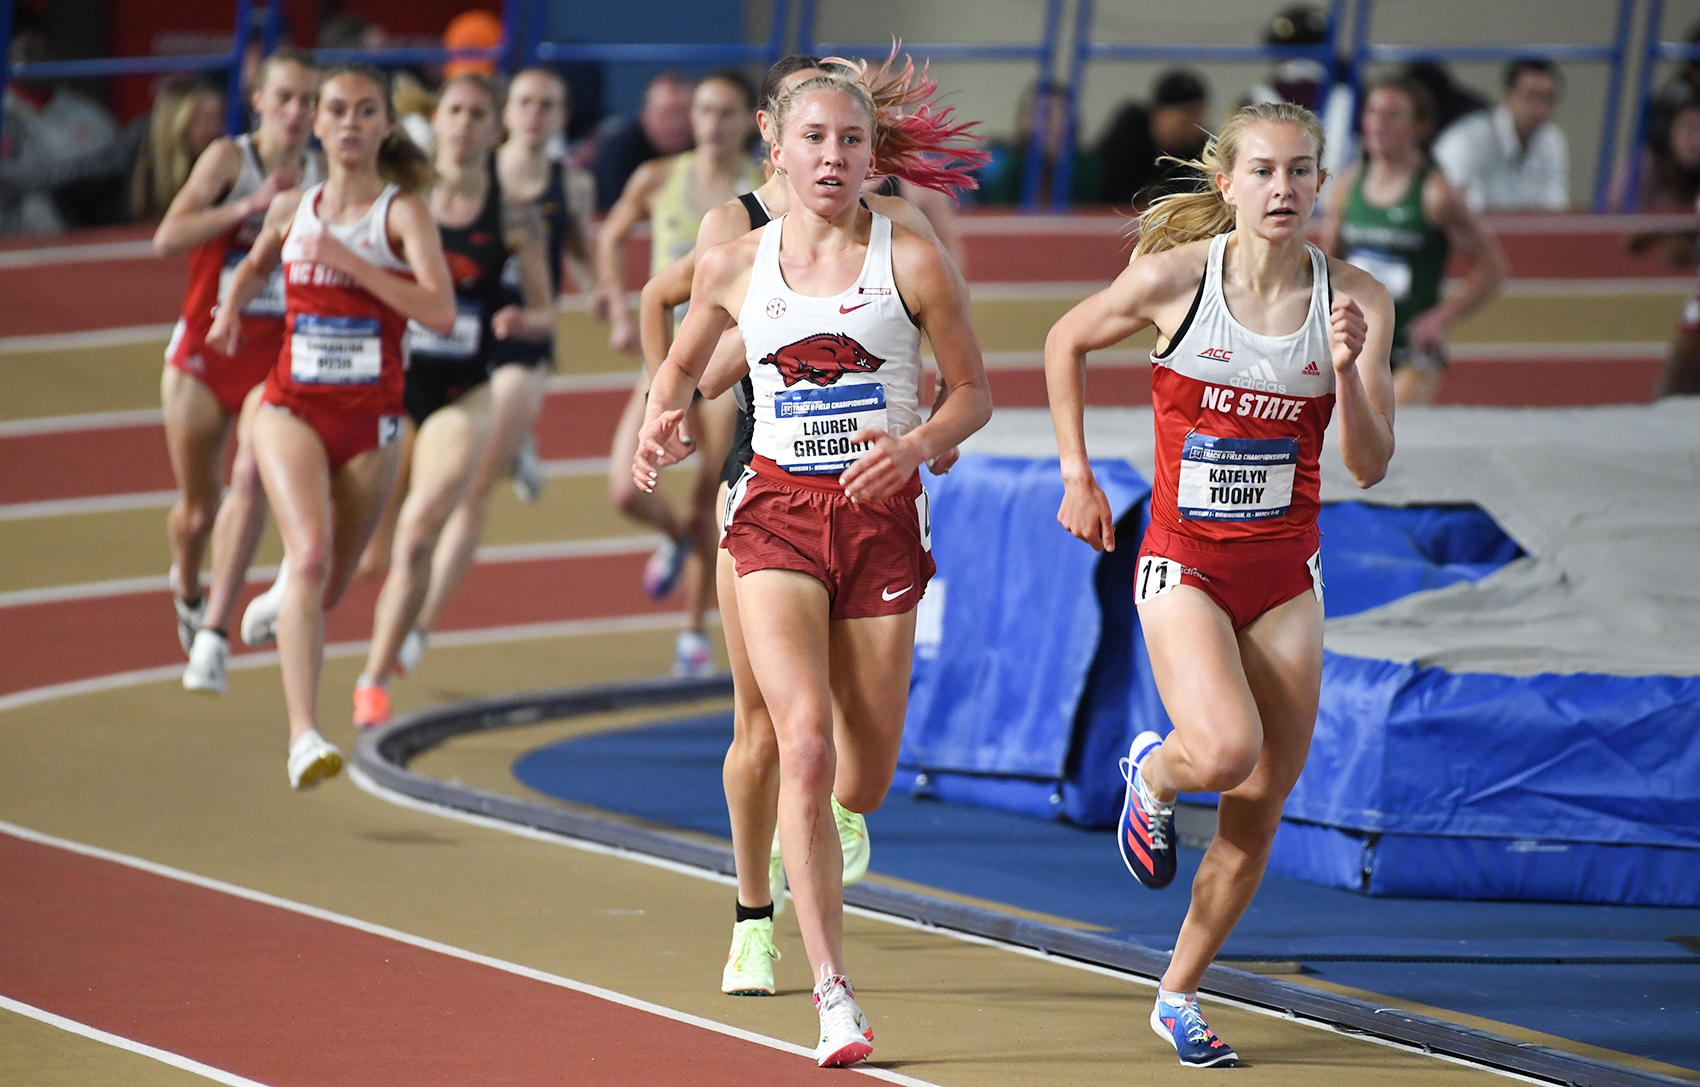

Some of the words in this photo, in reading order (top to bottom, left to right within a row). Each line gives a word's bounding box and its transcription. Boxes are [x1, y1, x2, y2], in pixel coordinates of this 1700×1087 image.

[1201, 348, 1233, 360] ACC
[1230, 377, 1287, 393] adidas
[831, 397, 878, 409] CHAMPIONSHIPS
[1201, 386, 1235, 413] NC
[1236, 393, 1307, 421] STATE
[804, 418, 858, 435] LAUREN
[1243, 453, 1290, 461] CHAMPIONSHIPS
[1209, 469, 1267, 484] KATELYN
[1210, 487, 1265, 504] TUOHY
[1142, 560, 1168, 599] 11
